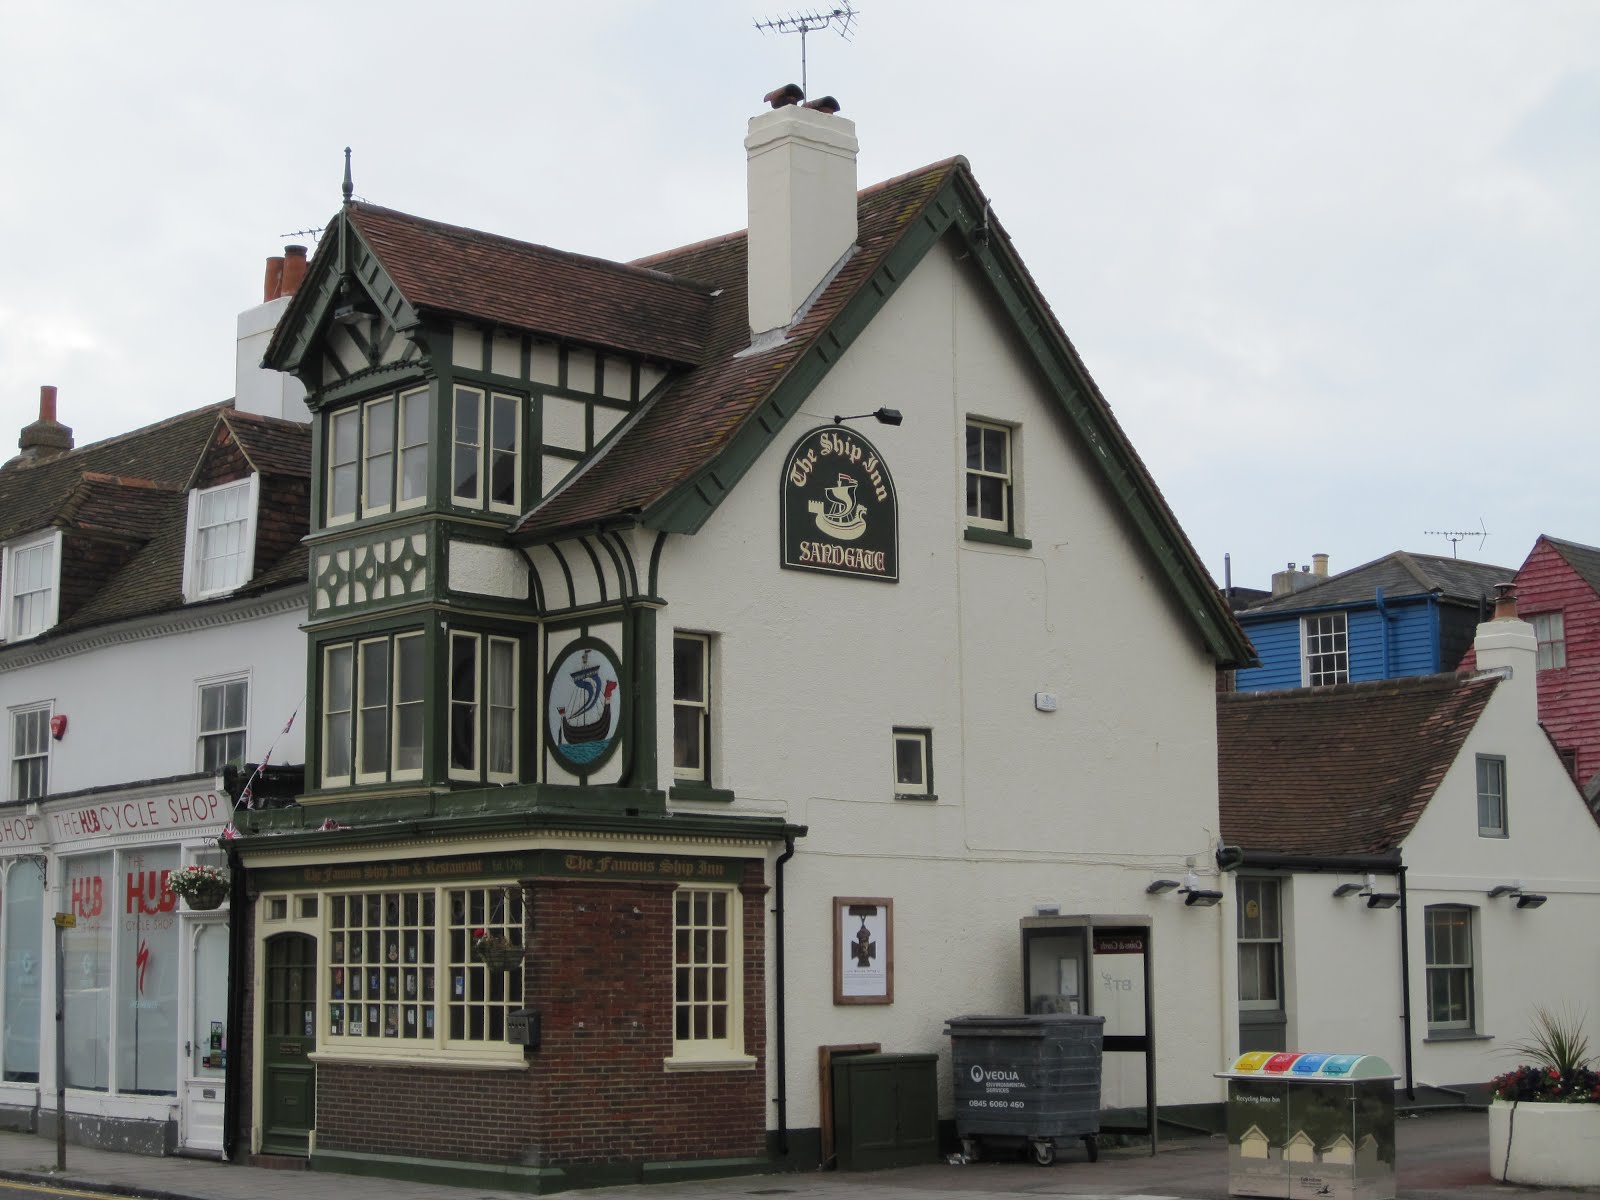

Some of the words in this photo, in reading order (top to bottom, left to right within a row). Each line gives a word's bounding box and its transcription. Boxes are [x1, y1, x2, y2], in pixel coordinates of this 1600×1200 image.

[790, 448, 818, 487] The
[820, 432, 862, 464] Ship
[862, 451, 888, 502] Inn
[799, 540, 886, 571] SANDGATE
[54, 812, 81, 837] THE
[78, 809, 101, 834] HUB
[100, 801, 159, 831] CYCLE
[168, 794, 218, 824] SHOP
[0, 818, 34, 842] HOP
[127, 855, 145, 868] THE
[426, 860, 483, 874] Restaurant
[564, 854, 593, 871] The
[595, 856, 655, 873] Famous
[659, 858, 694, 876] Ship
[696, 859, 724, 876] Inn
[71, 876, 103, 919] HUB
[126, 869, 177, 915] HUB
[126, 920, 150, 931] CYCLE
[153, 919, 174, 930] SHOP
[984, 1071, 1019, 1080] VEOLIA
[1236, 1094, 1259, 1104] Recycling
[1259, 1095, 1271, 1103] litter
